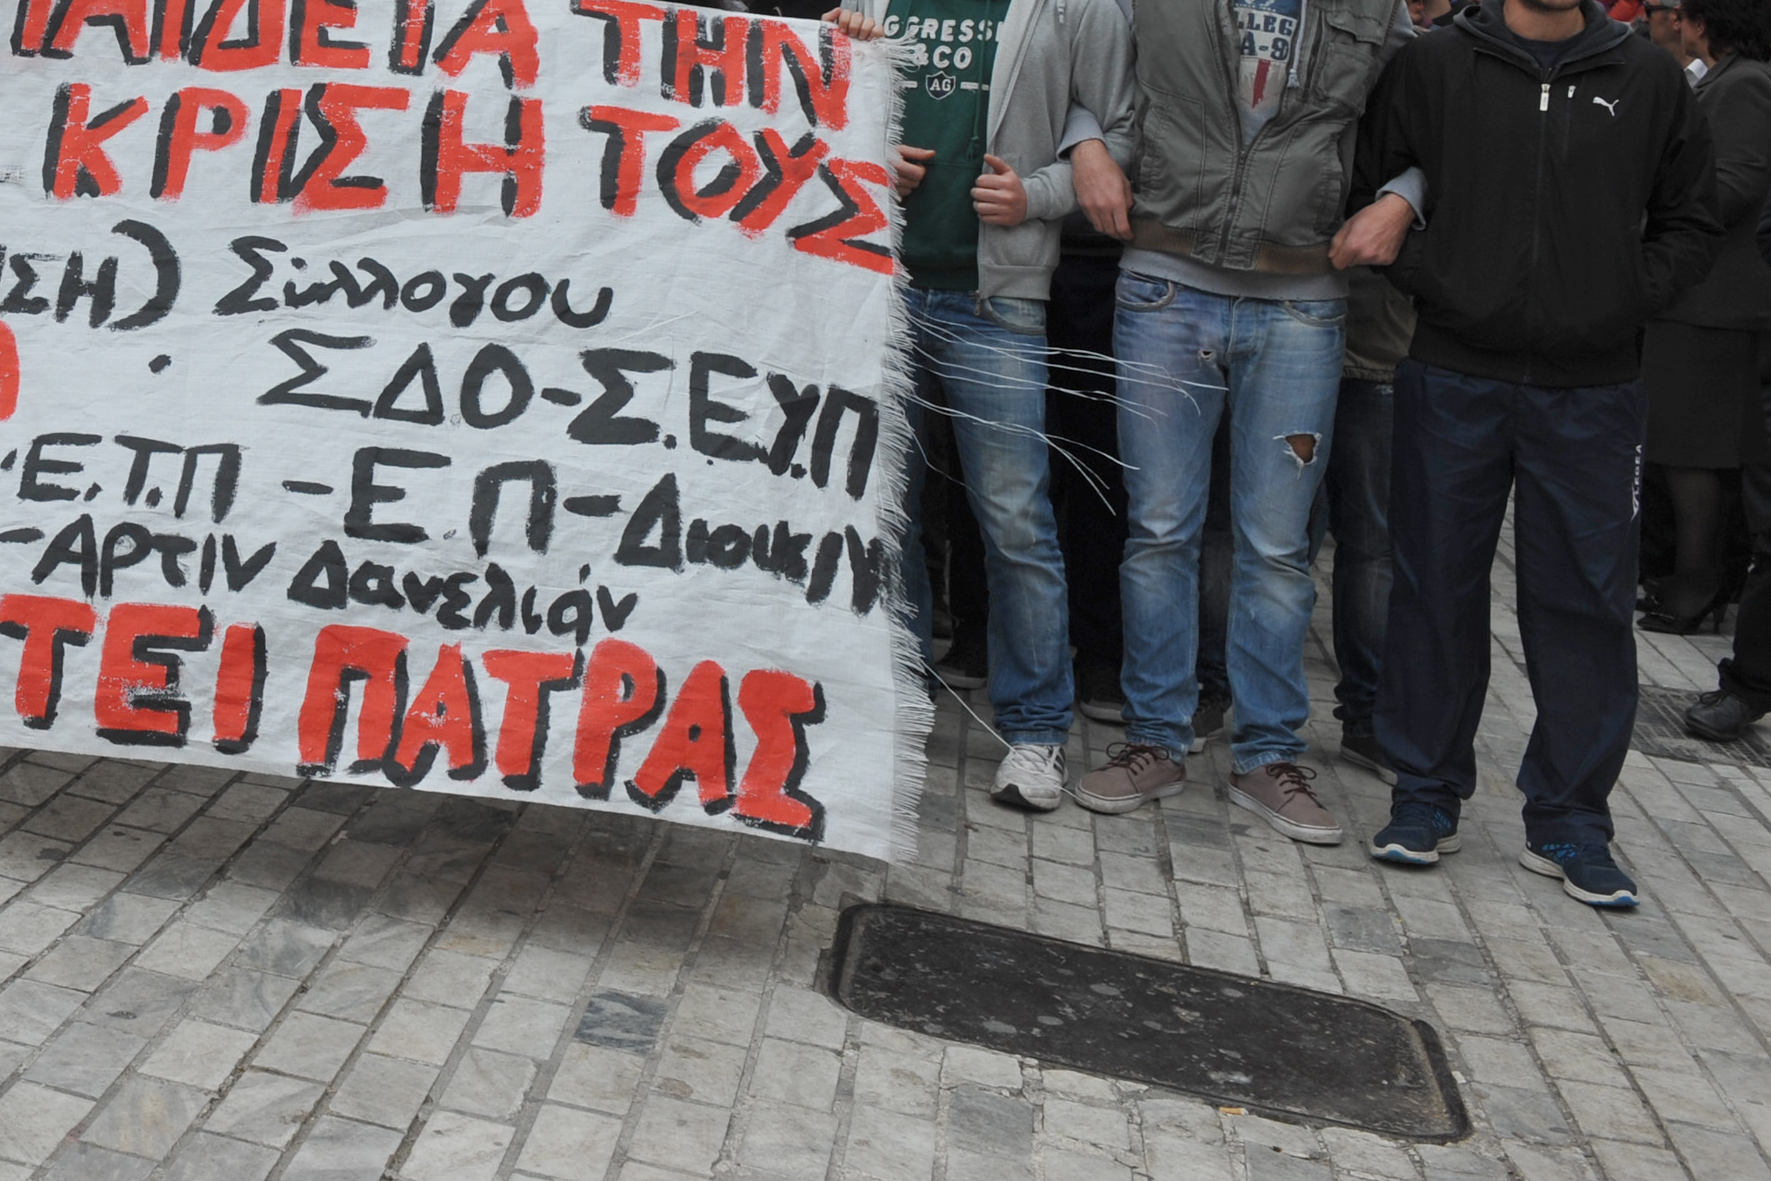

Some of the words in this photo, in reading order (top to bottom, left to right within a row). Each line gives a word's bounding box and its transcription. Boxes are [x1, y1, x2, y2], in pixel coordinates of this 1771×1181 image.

[41, 80, 546, 219] ΚΡΙΣΗ
[577, 104, 894, 276] ΤΟΥΣ
[929, 78, 952, 92] AG
[295, 622, 828, 842] ΠΑΤΡΑΣ
